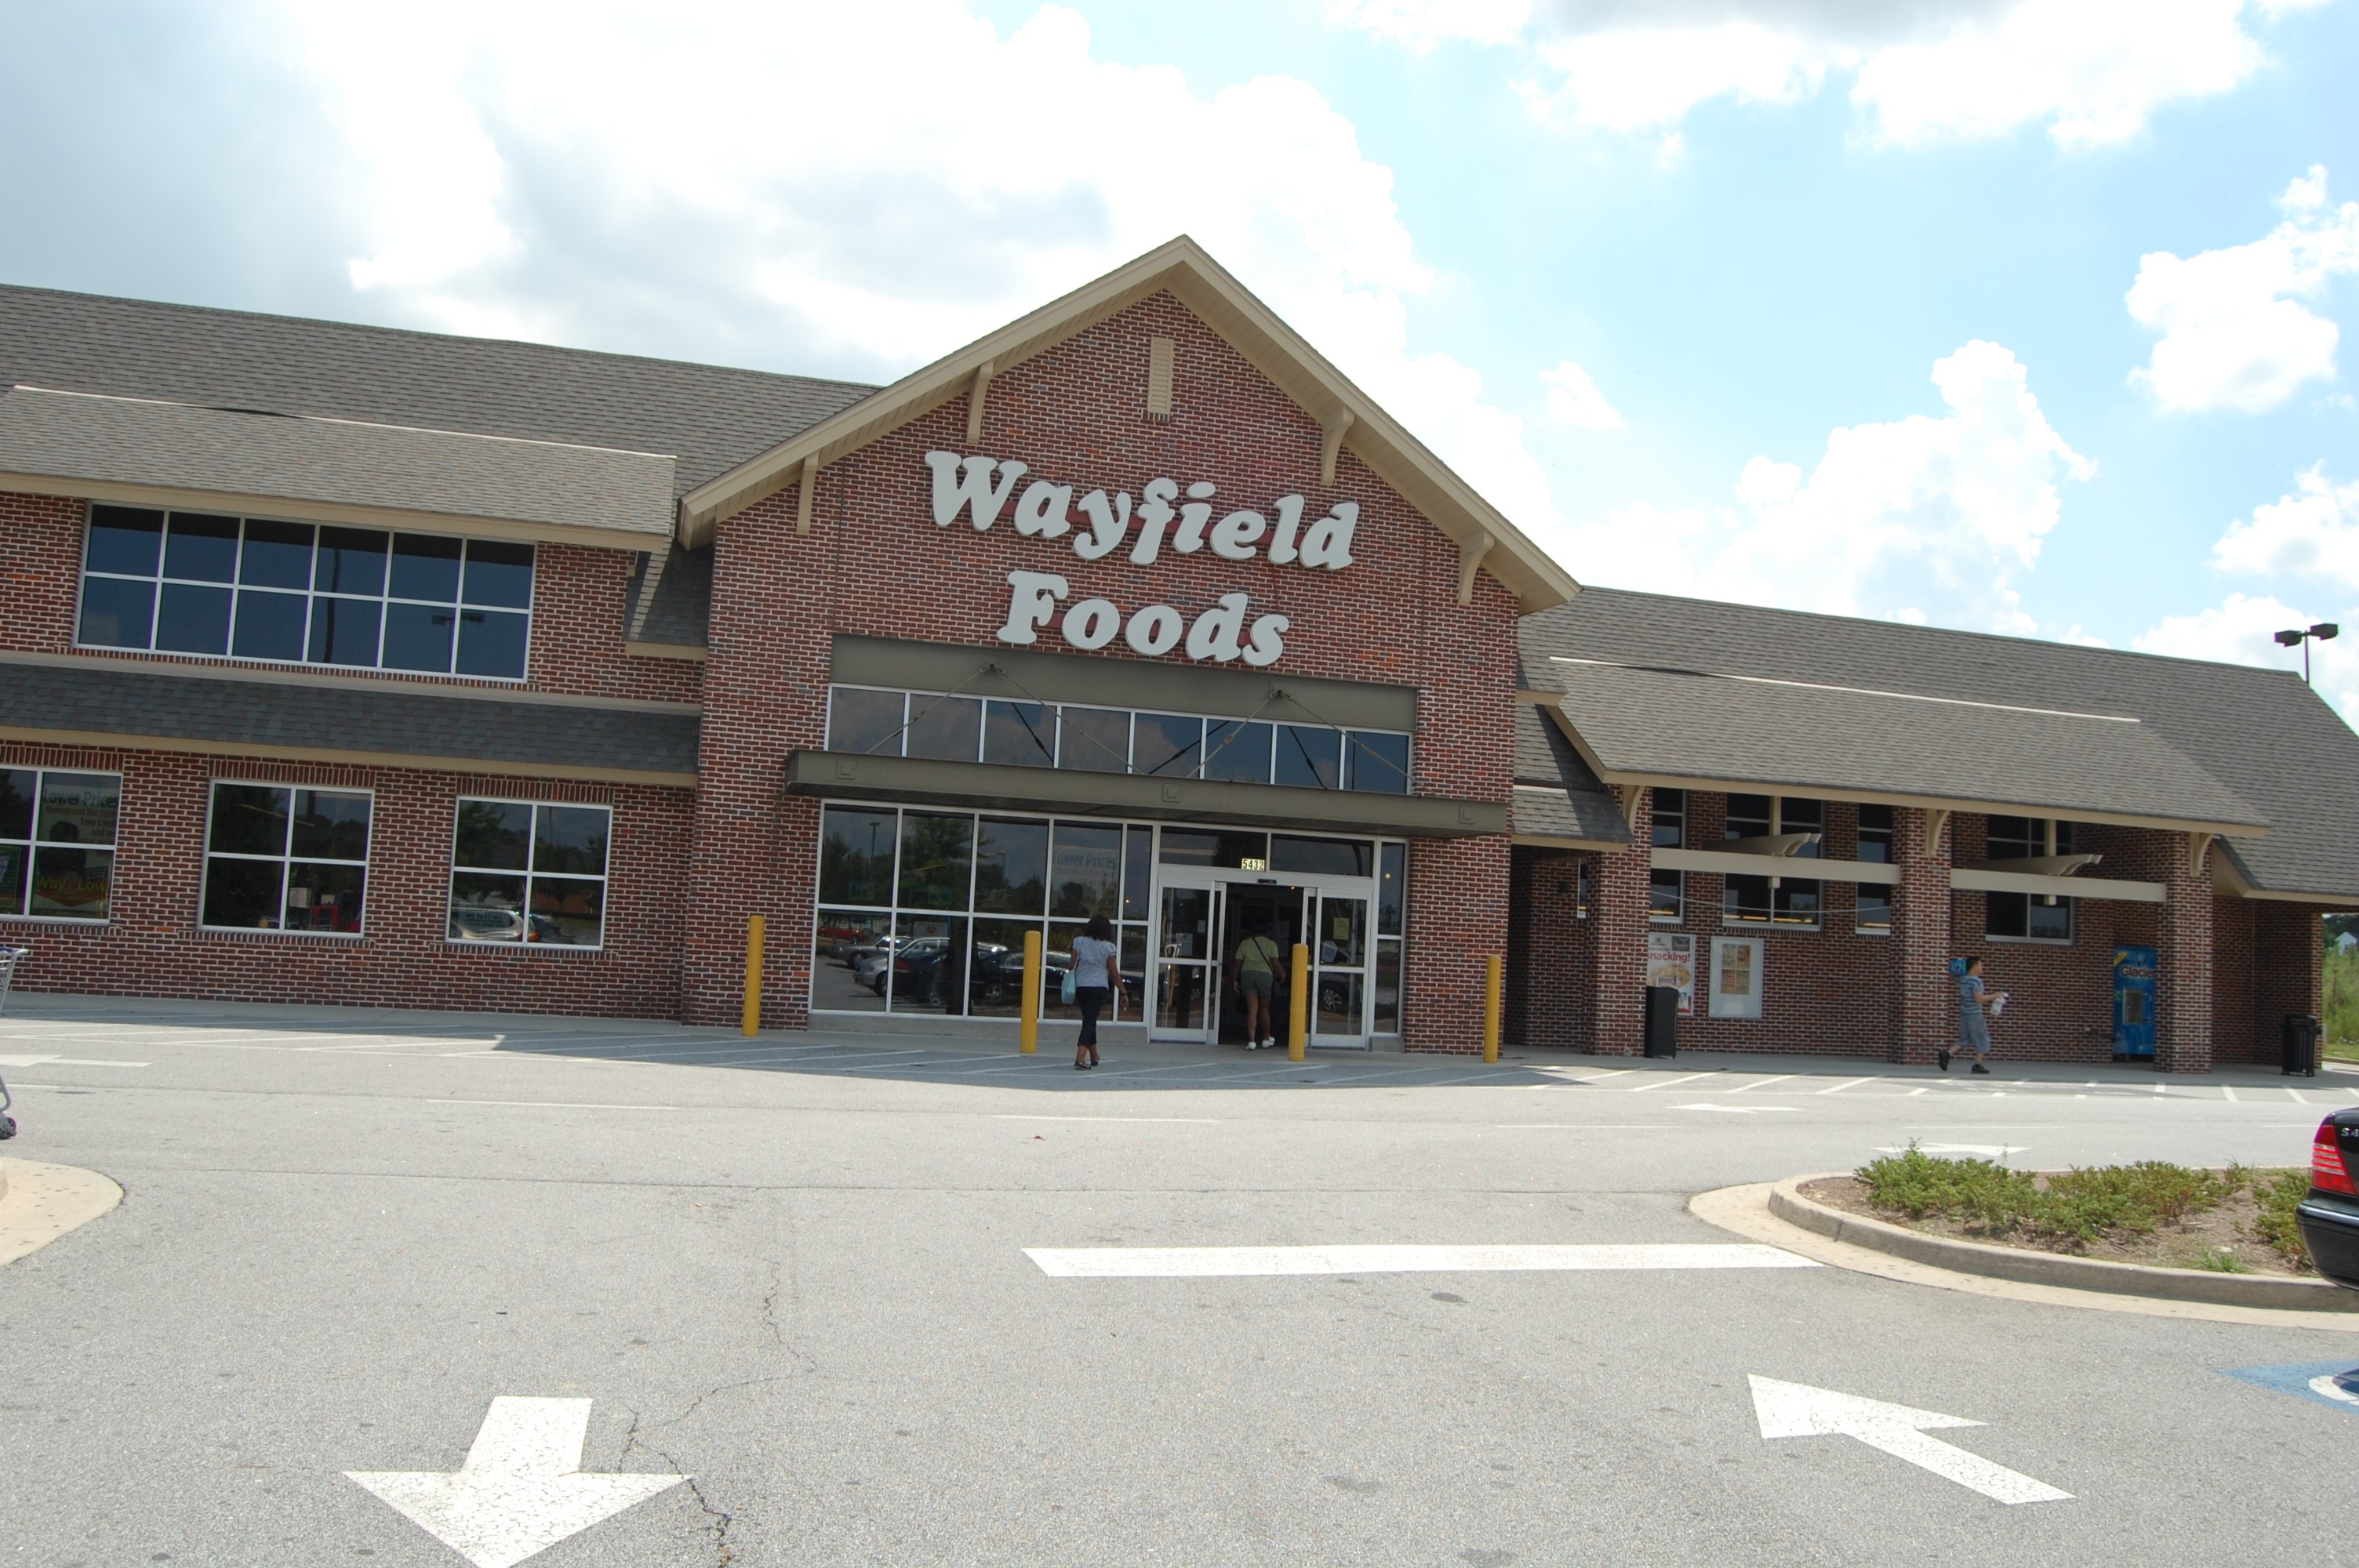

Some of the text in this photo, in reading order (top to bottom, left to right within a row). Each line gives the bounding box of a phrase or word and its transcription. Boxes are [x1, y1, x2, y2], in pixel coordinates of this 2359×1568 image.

[925, 451, 1360, 570] Wayfield
[996, 570, 1289, 666] Foods
[44, 788, 118, 808] Lower Prices
[1053, 851, 1117, 868] Lower Prices
[1242, 858, 1263, 869] 5432
